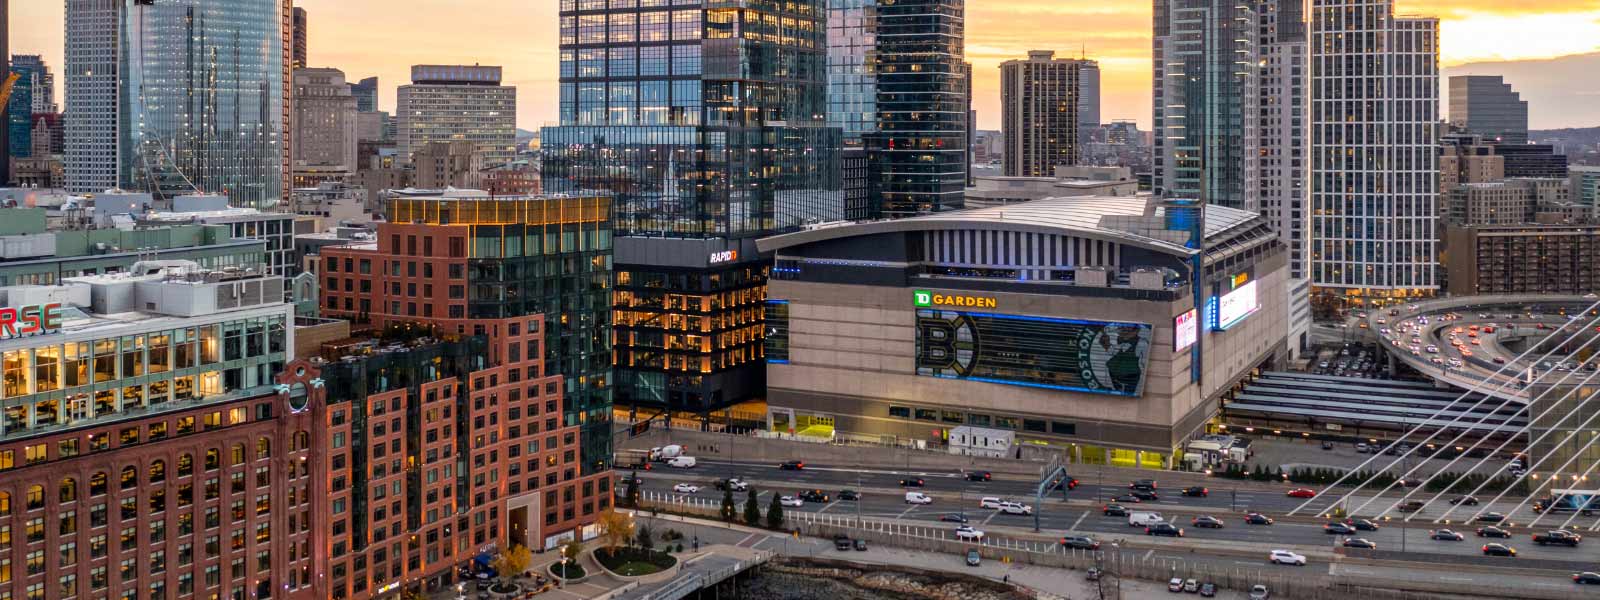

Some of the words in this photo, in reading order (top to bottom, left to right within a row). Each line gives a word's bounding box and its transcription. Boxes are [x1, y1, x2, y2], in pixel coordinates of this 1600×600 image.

[914, 293, 930, 304] TD
[932, 294, 996, 308] GARDEN
[919, 319, 956, 369] B
